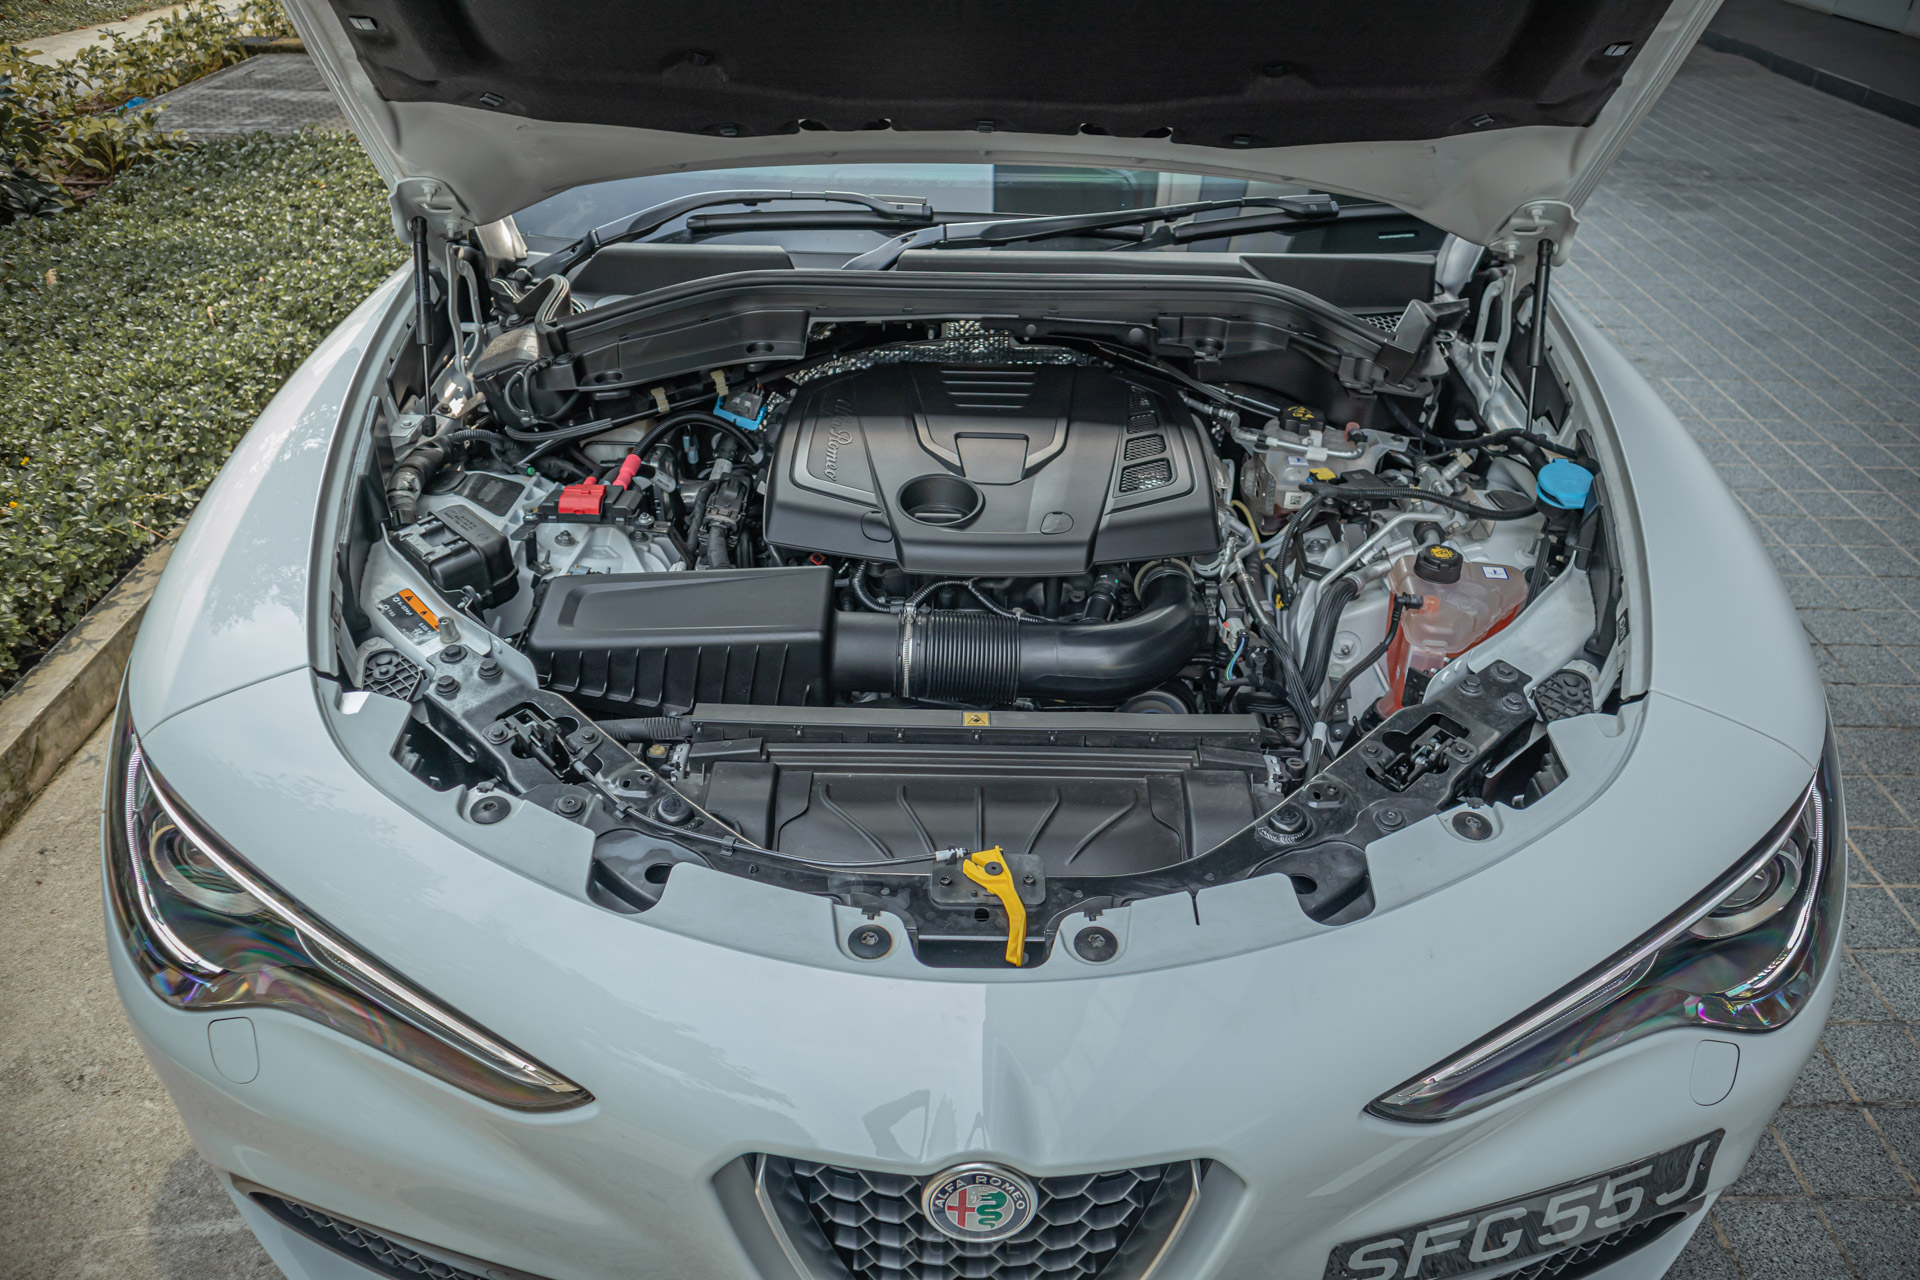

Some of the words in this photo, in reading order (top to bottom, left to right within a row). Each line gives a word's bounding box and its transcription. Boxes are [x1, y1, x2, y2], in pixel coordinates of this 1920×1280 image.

[824, 428, 853, 481] Romeo
[934, 1179, 967, 1209] ALFA
[974, 1175, 1026, 1210] ROMEO
